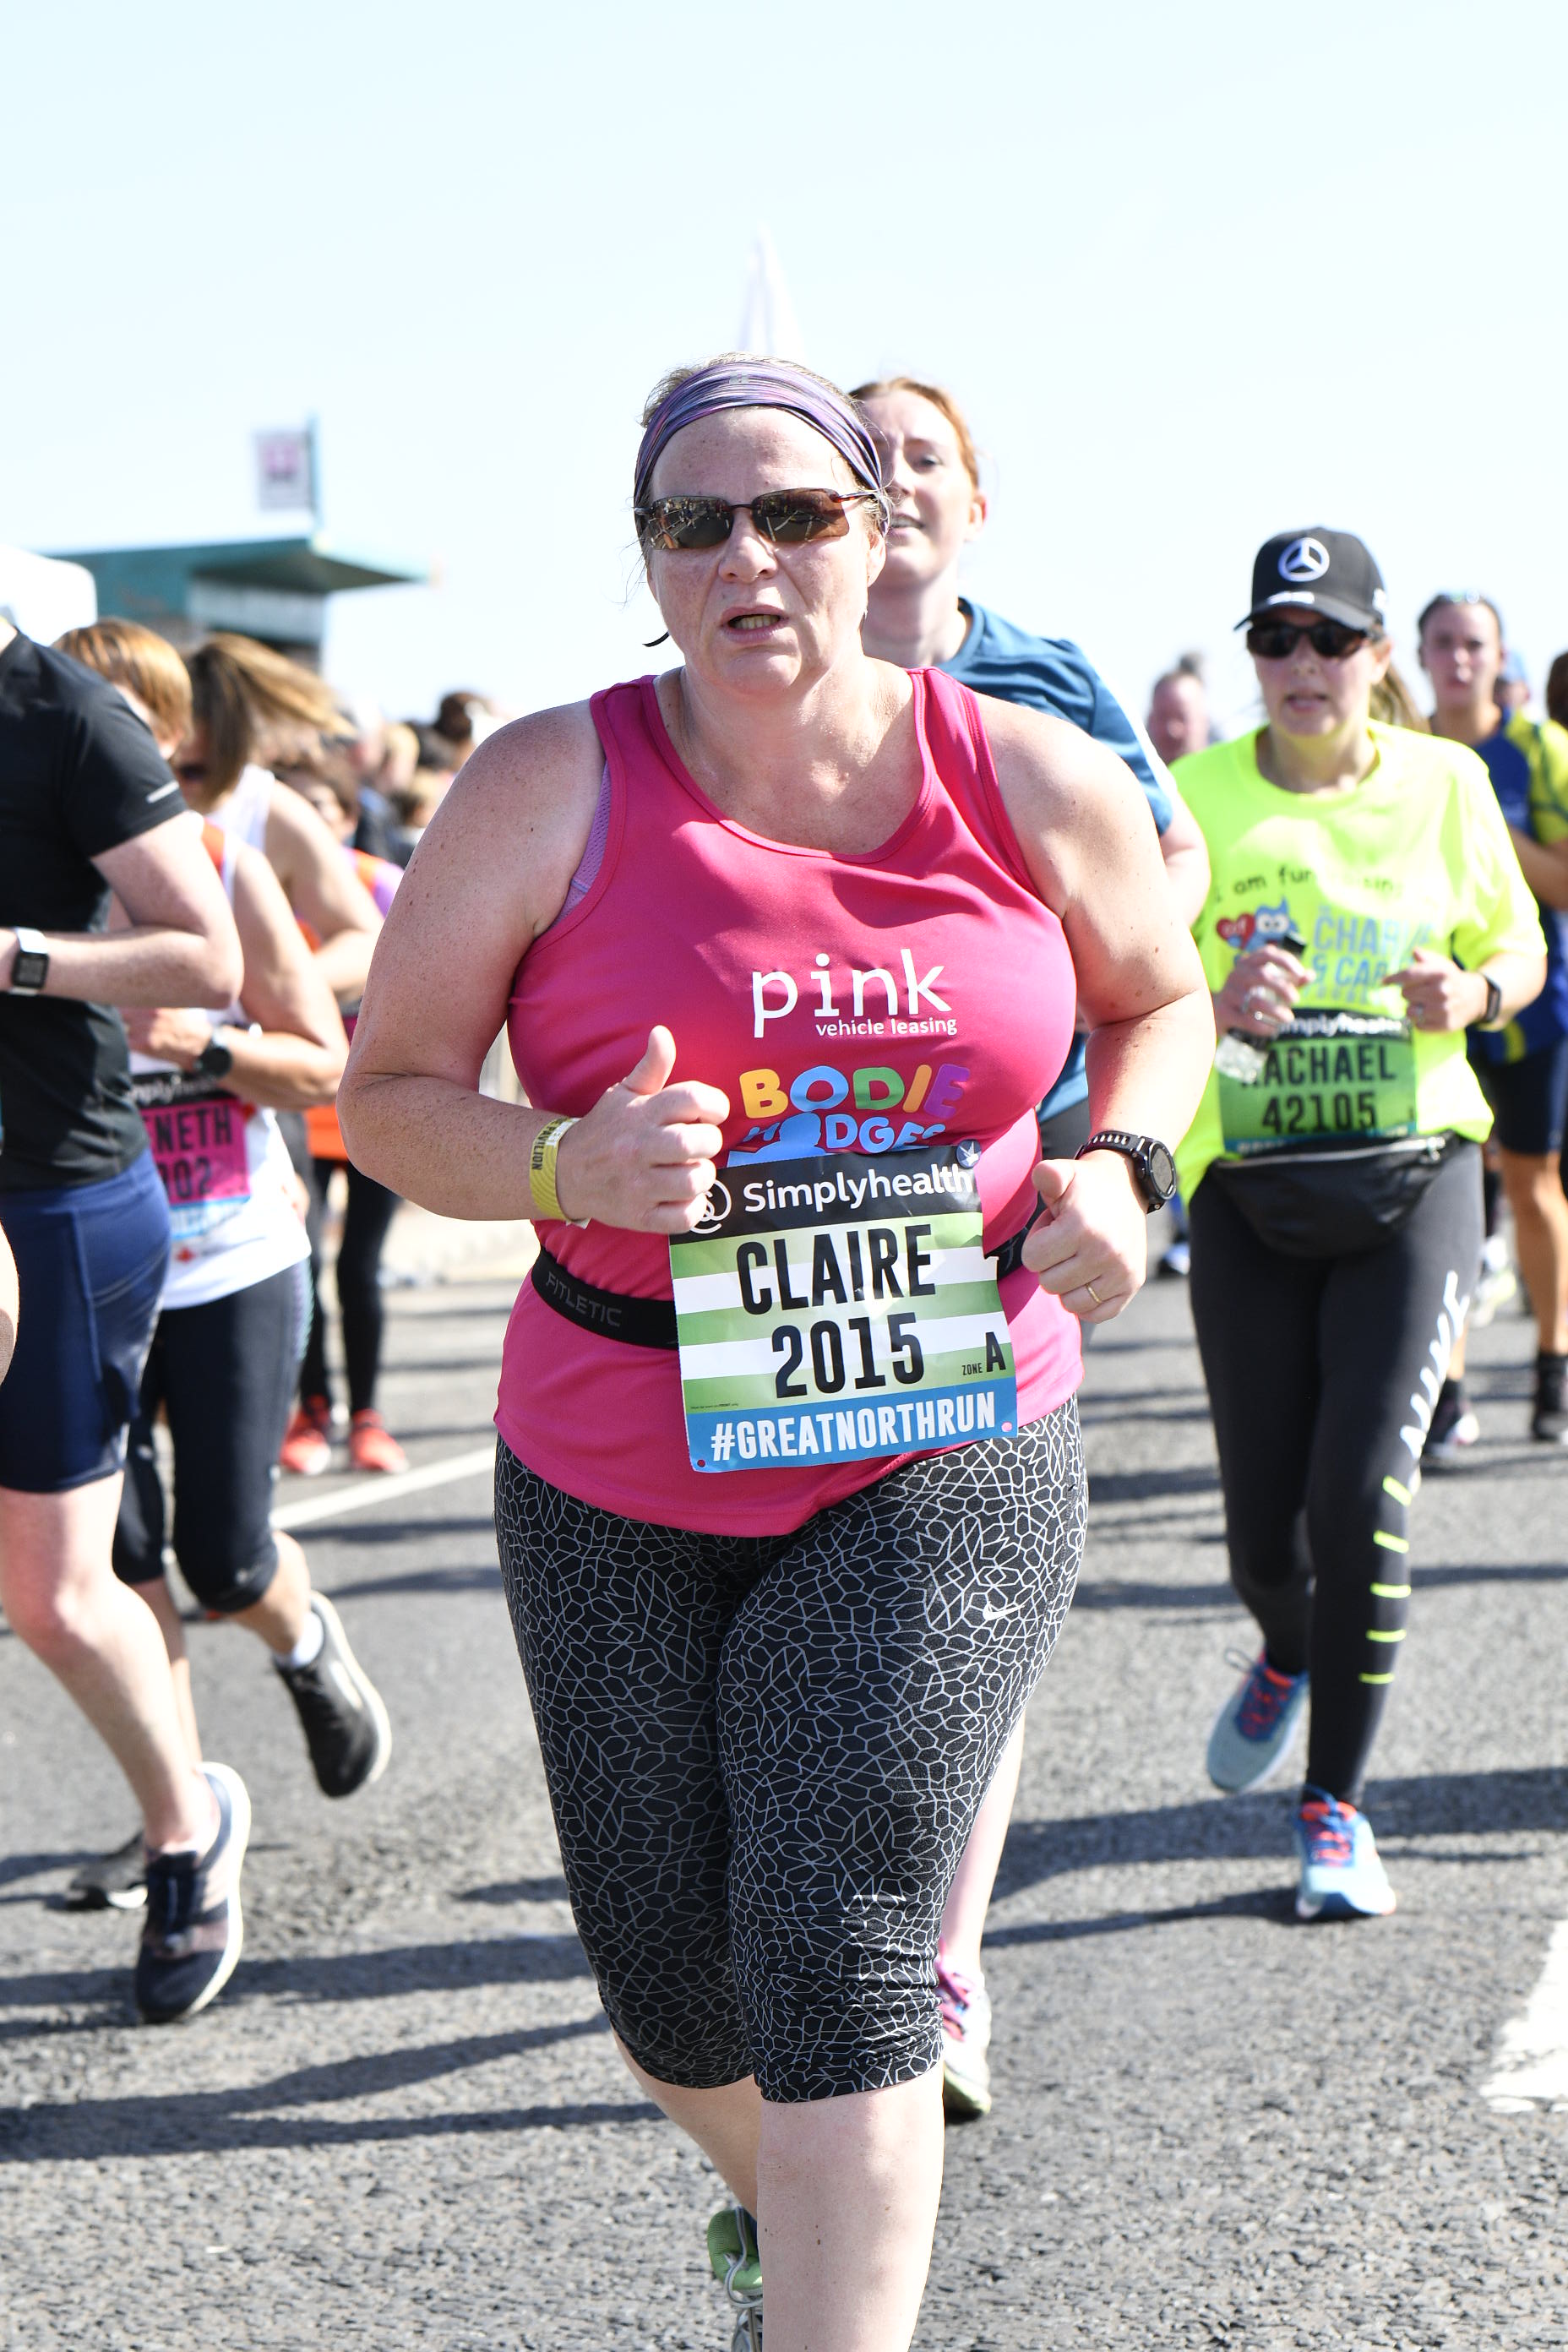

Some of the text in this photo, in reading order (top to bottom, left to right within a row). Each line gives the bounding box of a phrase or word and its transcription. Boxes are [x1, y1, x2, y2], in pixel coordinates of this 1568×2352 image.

[1233, 875, 1266, 896] am
[753, 949, 952, 1038] pink
[1336, 956, 1388, 988] CAR
[815, 1017, 957, 1037] vehicle leasing
[1241, 1043, 1397, 1088] ACHAEL
[739, 1064, 972, 1119] BODIE
[1262, 1090, 1377, 1135] 42105
[142, 1104, 233, 1155] NETH
[743, 1162, 974, 1213] Simplyhealth
[736, 1223, 936, 1315] CLAIRE
[545, 1271, 623, 1328] FITLETIC
[770, 1312, 925, 1399] 2015
[961, 1331, 1006, 1376] ZONE A
[710, 1391, 996, 1462] #GREATNORTHRUN
